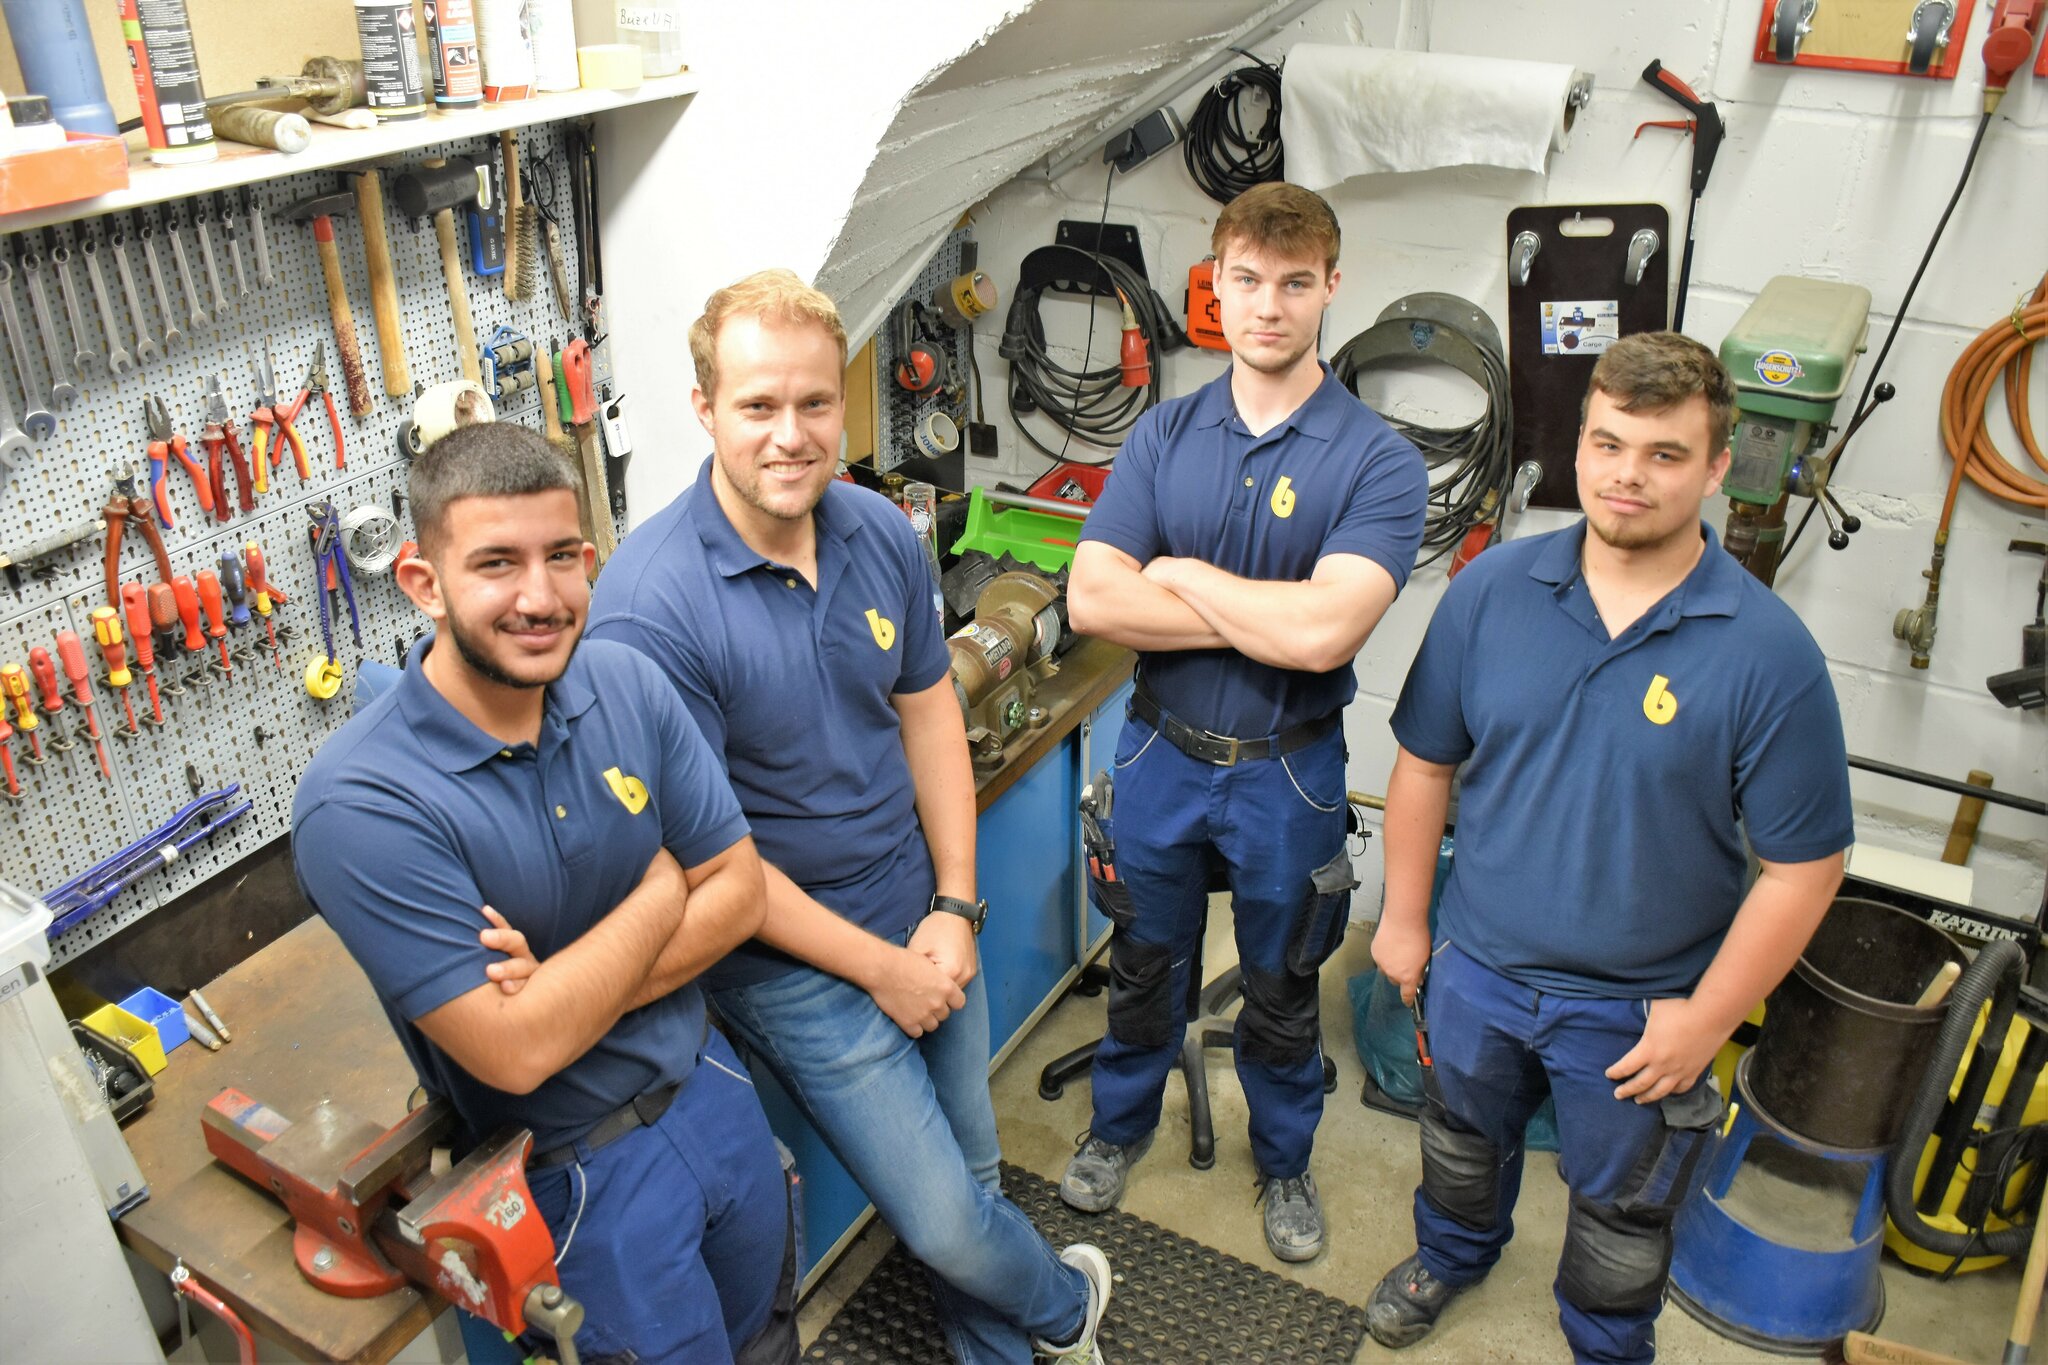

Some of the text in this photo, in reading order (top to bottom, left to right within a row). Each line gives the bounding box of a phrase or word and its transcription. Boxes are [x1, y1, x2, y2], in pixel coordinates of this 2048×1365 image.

[986, 639, 1012, 664] METABO
[1927, 909, 2020, 942] KATRIN
[0, 978, 21, 998] en
